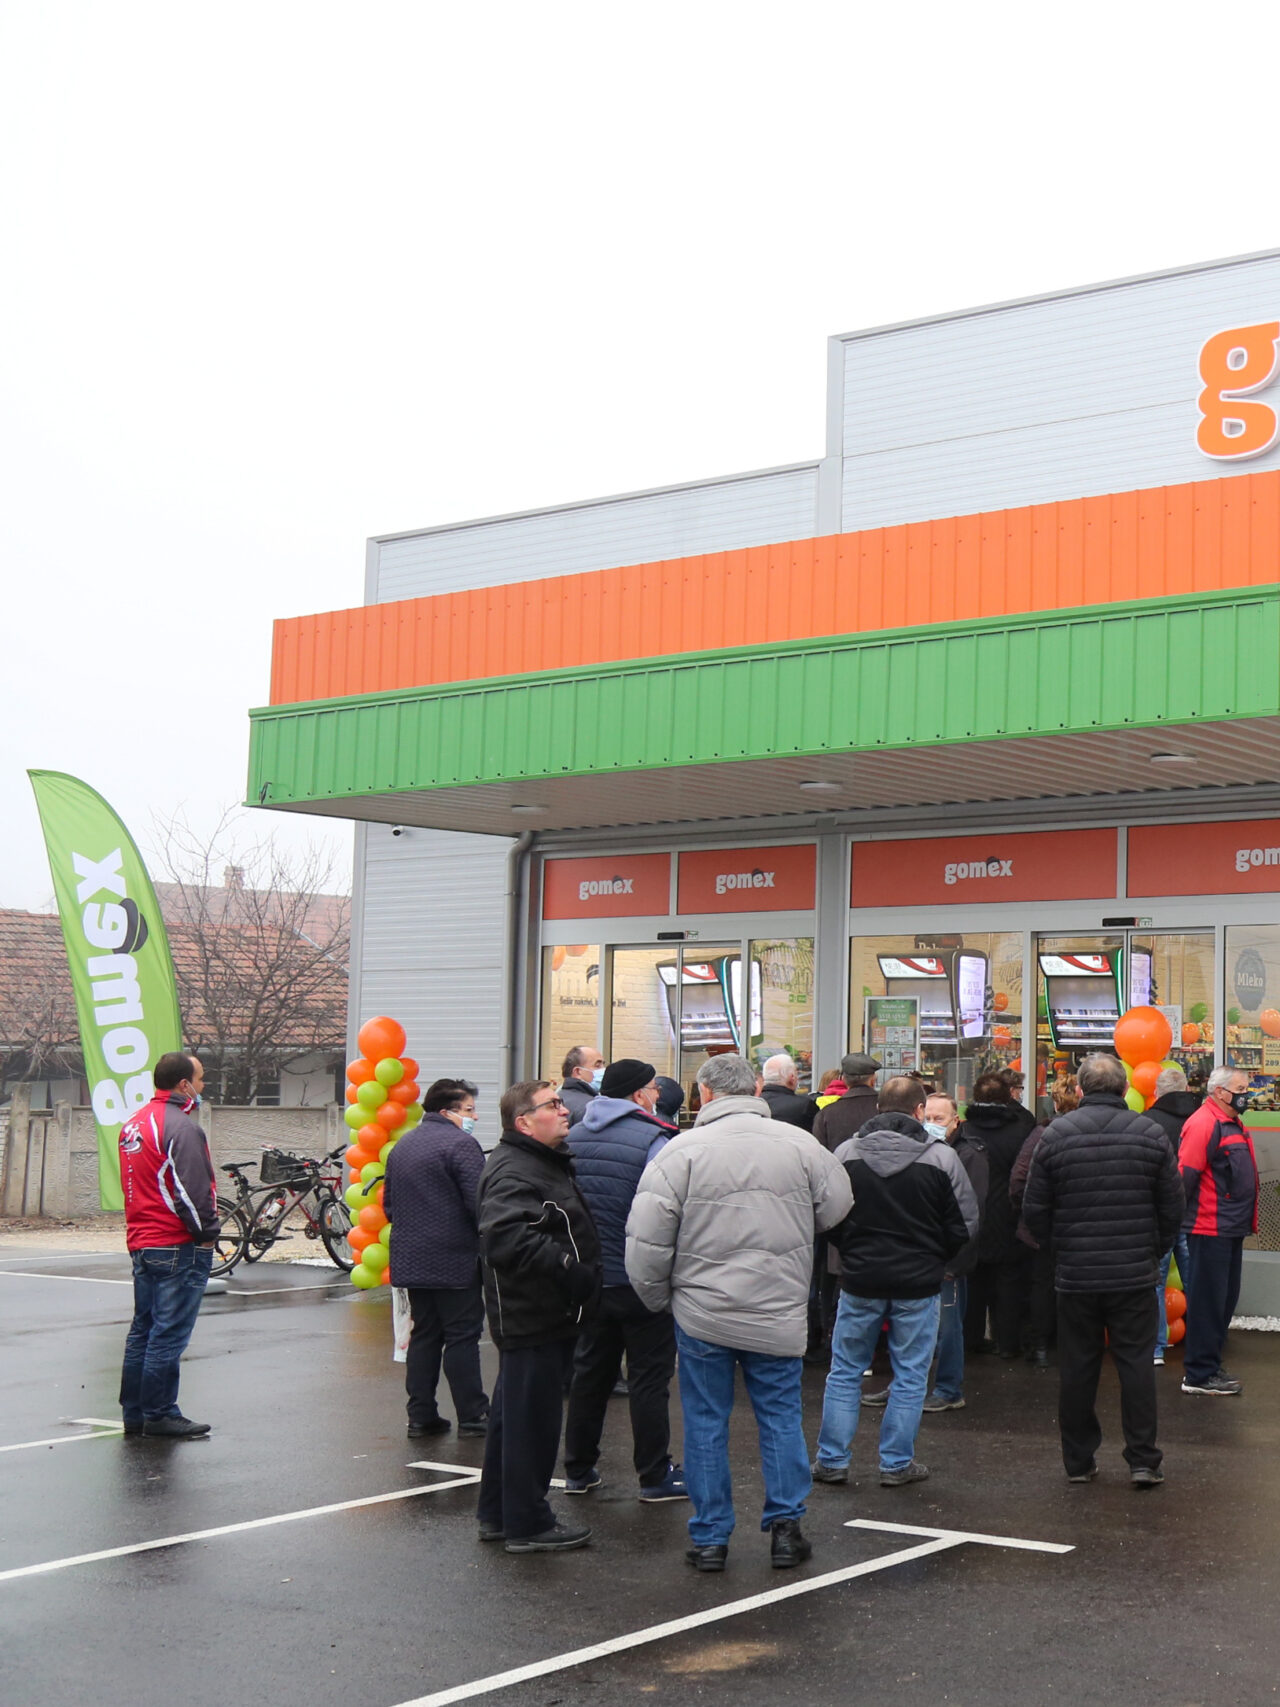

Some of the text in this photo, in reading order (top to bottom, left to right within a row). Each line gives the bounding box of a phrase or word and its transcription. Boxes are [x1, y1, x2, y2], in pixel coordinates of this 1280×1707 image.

[715, 870, 775, 895] gomex
[944, 859, 1013, 885] gomex
[579, 877, 633, 901] gomex
[1236, 972, 1264, 987] Mleko
